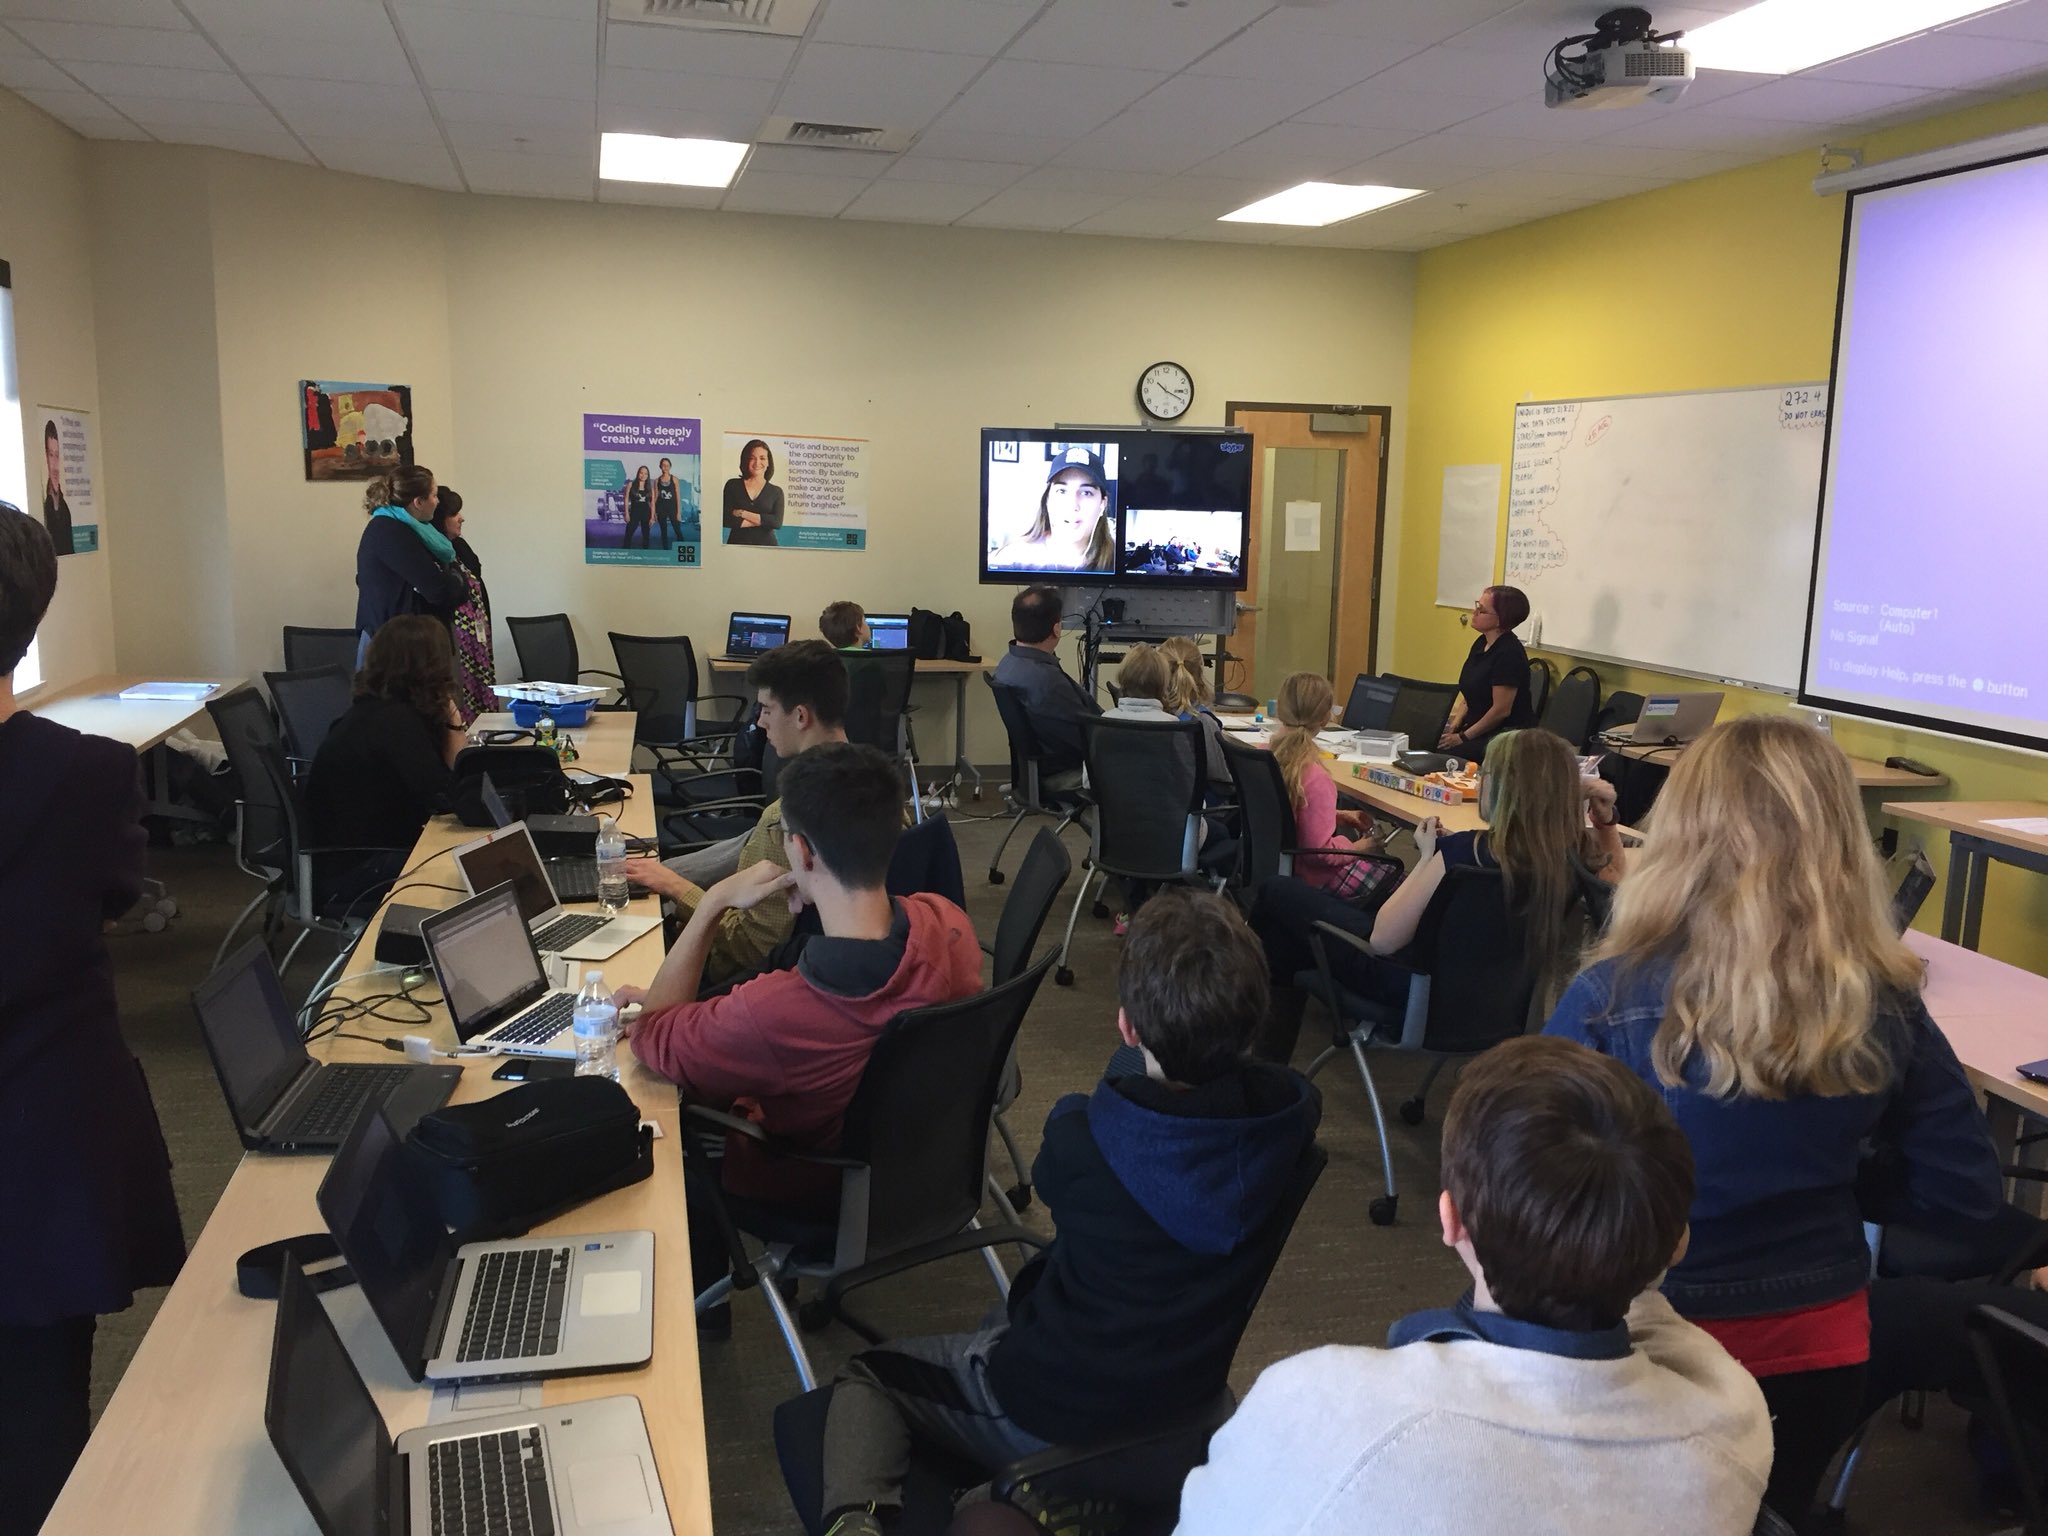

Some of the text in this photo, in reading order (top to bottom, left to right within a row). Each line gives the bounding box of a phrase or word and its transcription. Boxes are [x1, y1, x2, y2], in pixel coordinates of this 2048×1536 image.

[1796, 410, 1808, 420] NOT
[1810, 410, 1826, 418] ERAS
[642, 424, 652, 434] is
[654, 426, 692, 438] deeply
[601, 435, 646, 445] creative
[822, 444, 840, 452] boys
[802, 452, 846, 461] opportunity
[818, 468, 828, 476] By
[830, 469, 860, 478] building
[1879, 619, 1916, 636] (Auto)
[1830, 629, 1880, 646] No Signal
[1828, 658, 2028, 698] To display Help, press the button
